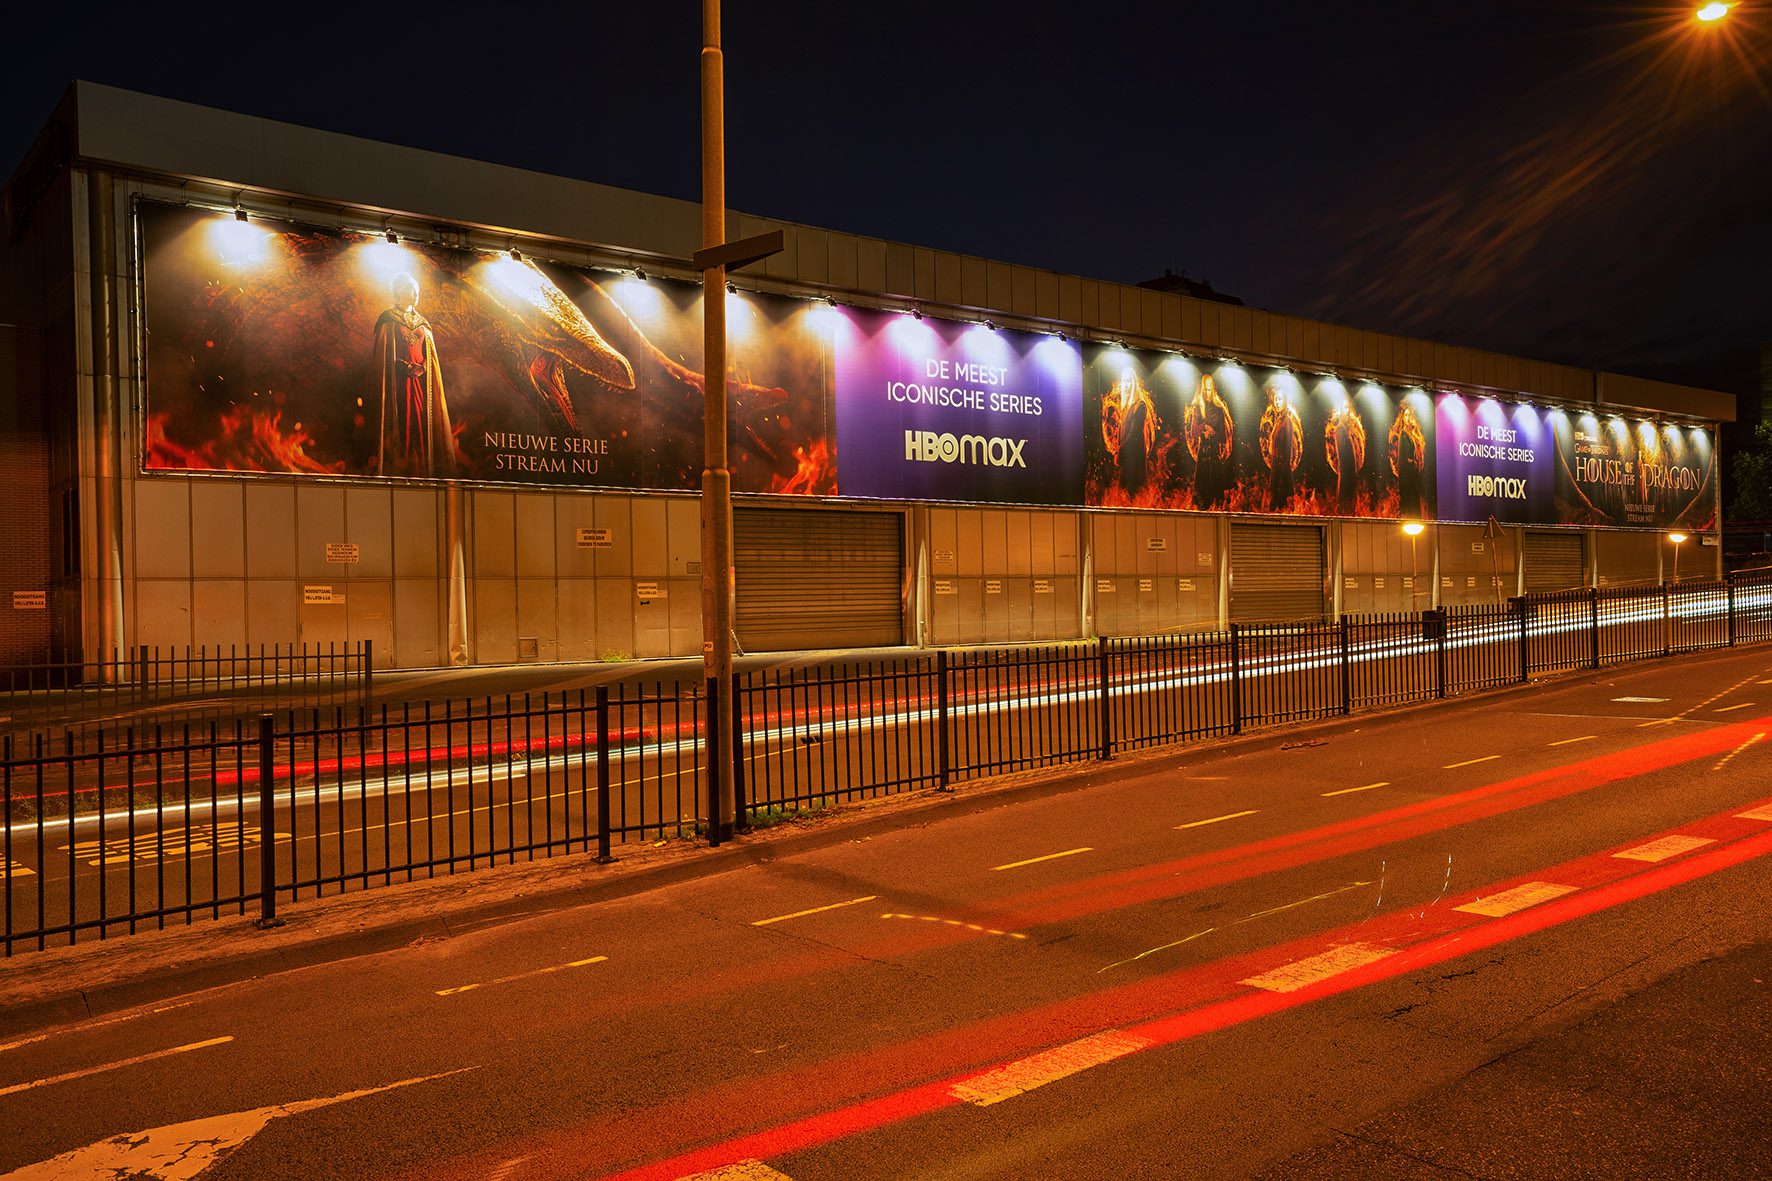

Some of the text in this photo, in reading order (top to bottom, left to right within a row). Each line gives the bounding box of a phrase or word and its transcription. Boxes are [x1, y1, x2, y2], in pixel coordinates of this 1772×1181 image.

[926, 358, 1007, 386] DE MEEST
[887, 381, 1043, 416] ICONISCHE SERIES
[485, 431, 609, 455] NIEUWE SERIE
[1477, 425, 1517, 443] DE MEEST
[495, 453, 599, 475] STREAM NU
[1459, 442, 1535, 463] ICONISCHE SERIES
[1575, 456, 1700, 491] HOUSE OF THE DRAGON
